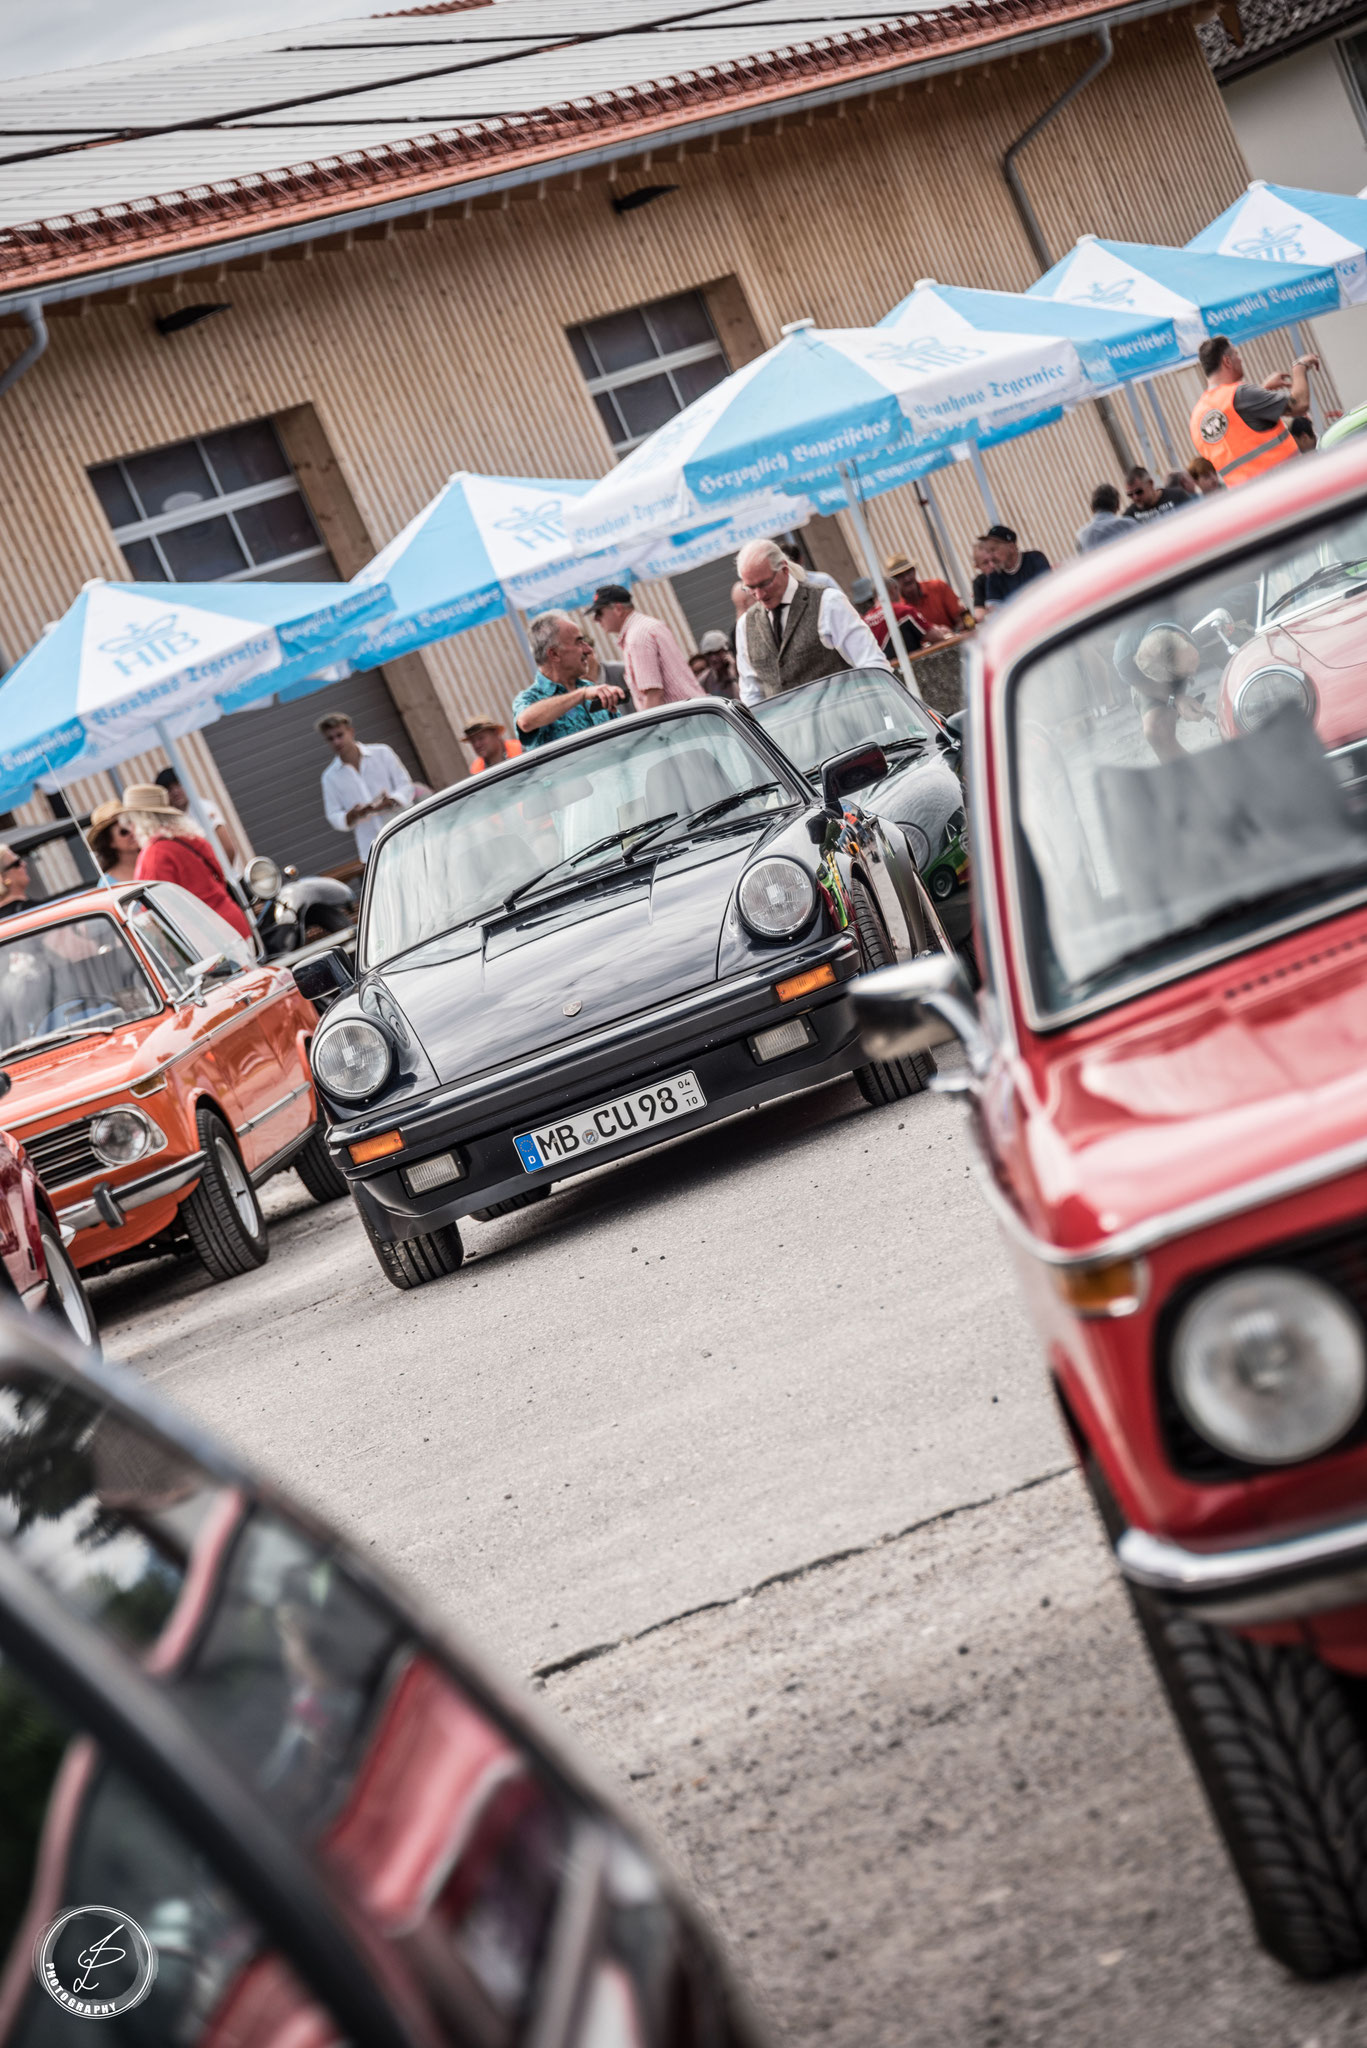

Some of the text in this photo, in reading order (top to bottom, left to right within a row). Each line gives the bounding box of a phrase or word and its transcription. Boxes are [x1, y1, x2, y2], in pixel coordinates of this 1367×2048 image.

[1206, 275, 1335, 327] Herzoglich Bayerisches
[913, 390, 986, 420] Brauhaus
[700, 451, 790, 495] Herzoglich
[790, 419, 891, 463] Bayerisches
[91, 677, 182, 726] Brauhaus
[677, 1078, 691, 1089] 04
[685, 1096, 698, 1107] 10
[535, 1086, 678, 1161] MB CU 98
[527, 1155, 536, 1165] D
